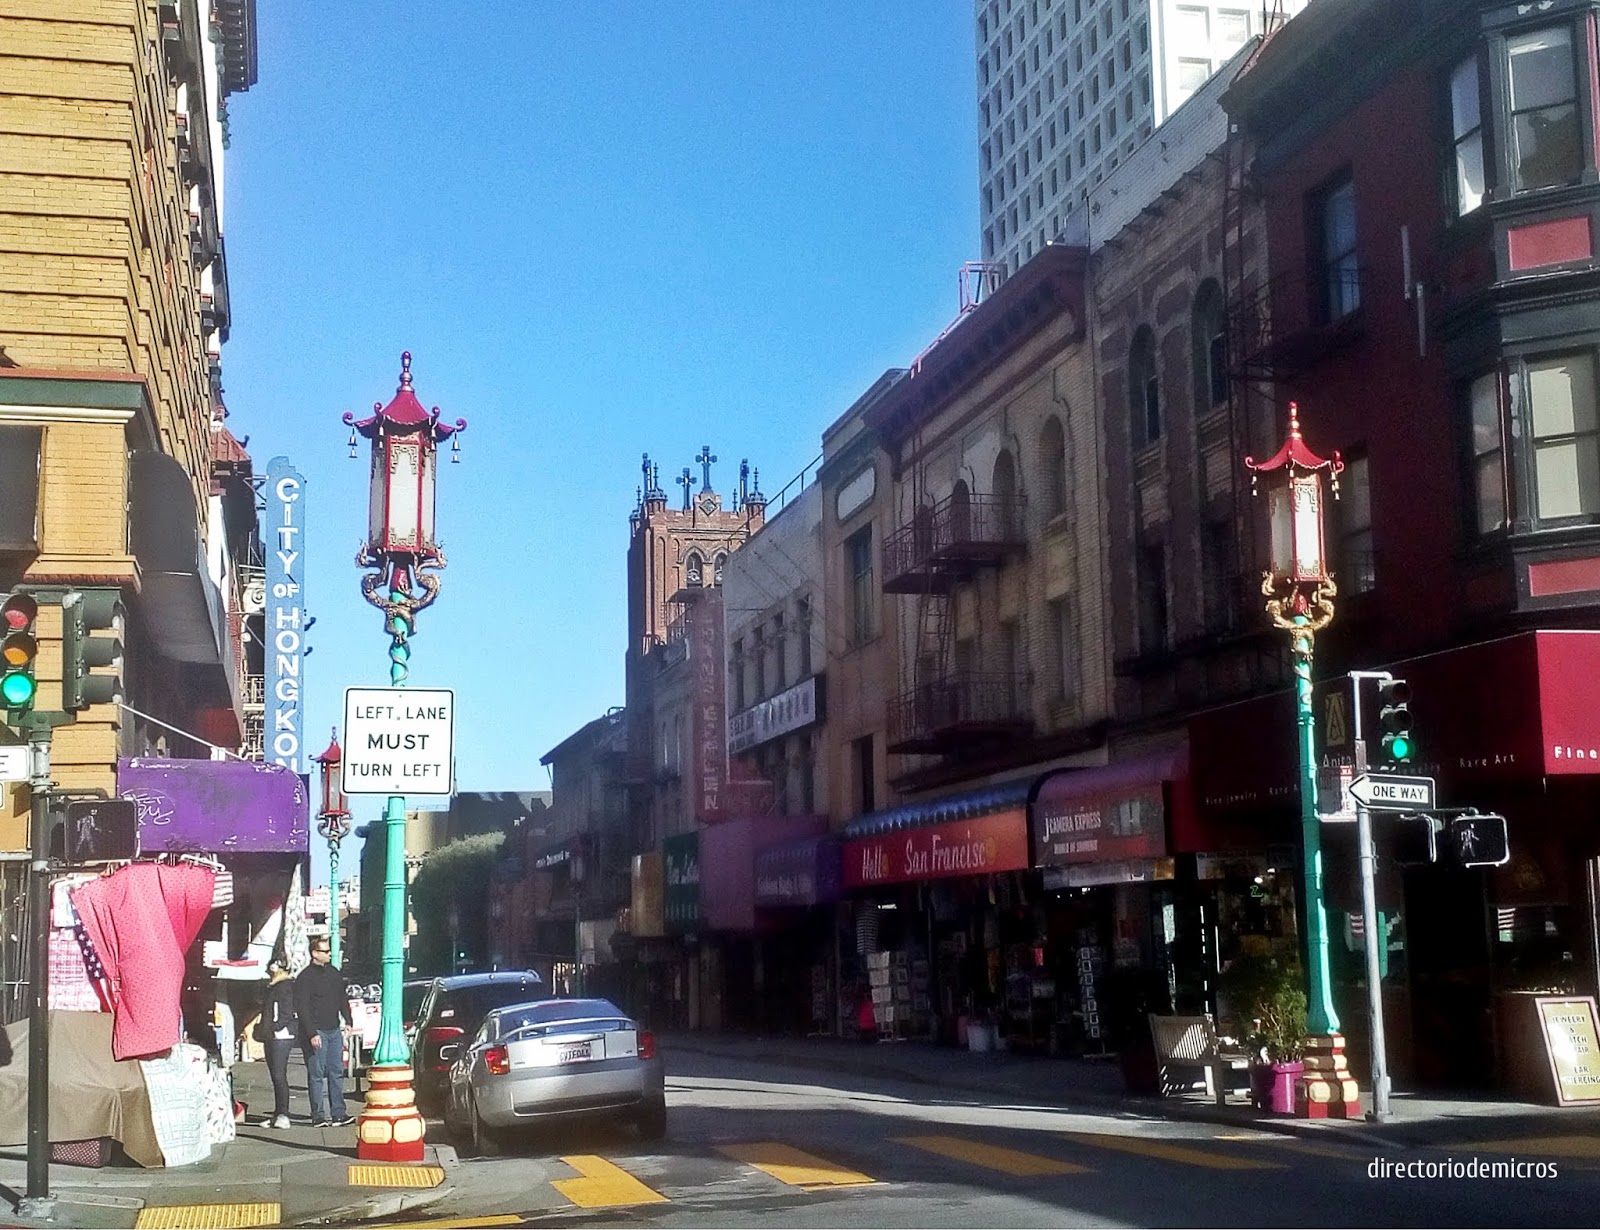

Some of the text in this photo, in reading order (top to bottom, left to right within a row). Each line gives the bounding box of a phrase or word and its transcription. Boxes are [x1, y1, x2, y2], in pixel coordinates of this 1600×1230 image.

[276, 477, 300, 575] CITY
[273, 583, 299, 598] OF
[276, 607, 300, 702] HONG
[356, 705, 446, 720] LEFT LANE
[367, 733, 430, 750] MUST
[1553, 745, 1598, 759] Fine
[1459, 757, 1487, 768] Rare
[1494, 753, 1516, 765] Art
[350, 763, 441, 777] TURN LEFT
[1373, 785, 1425, 800] ONE WAY
[861, 829, 996, 881] Hello San Francisco
